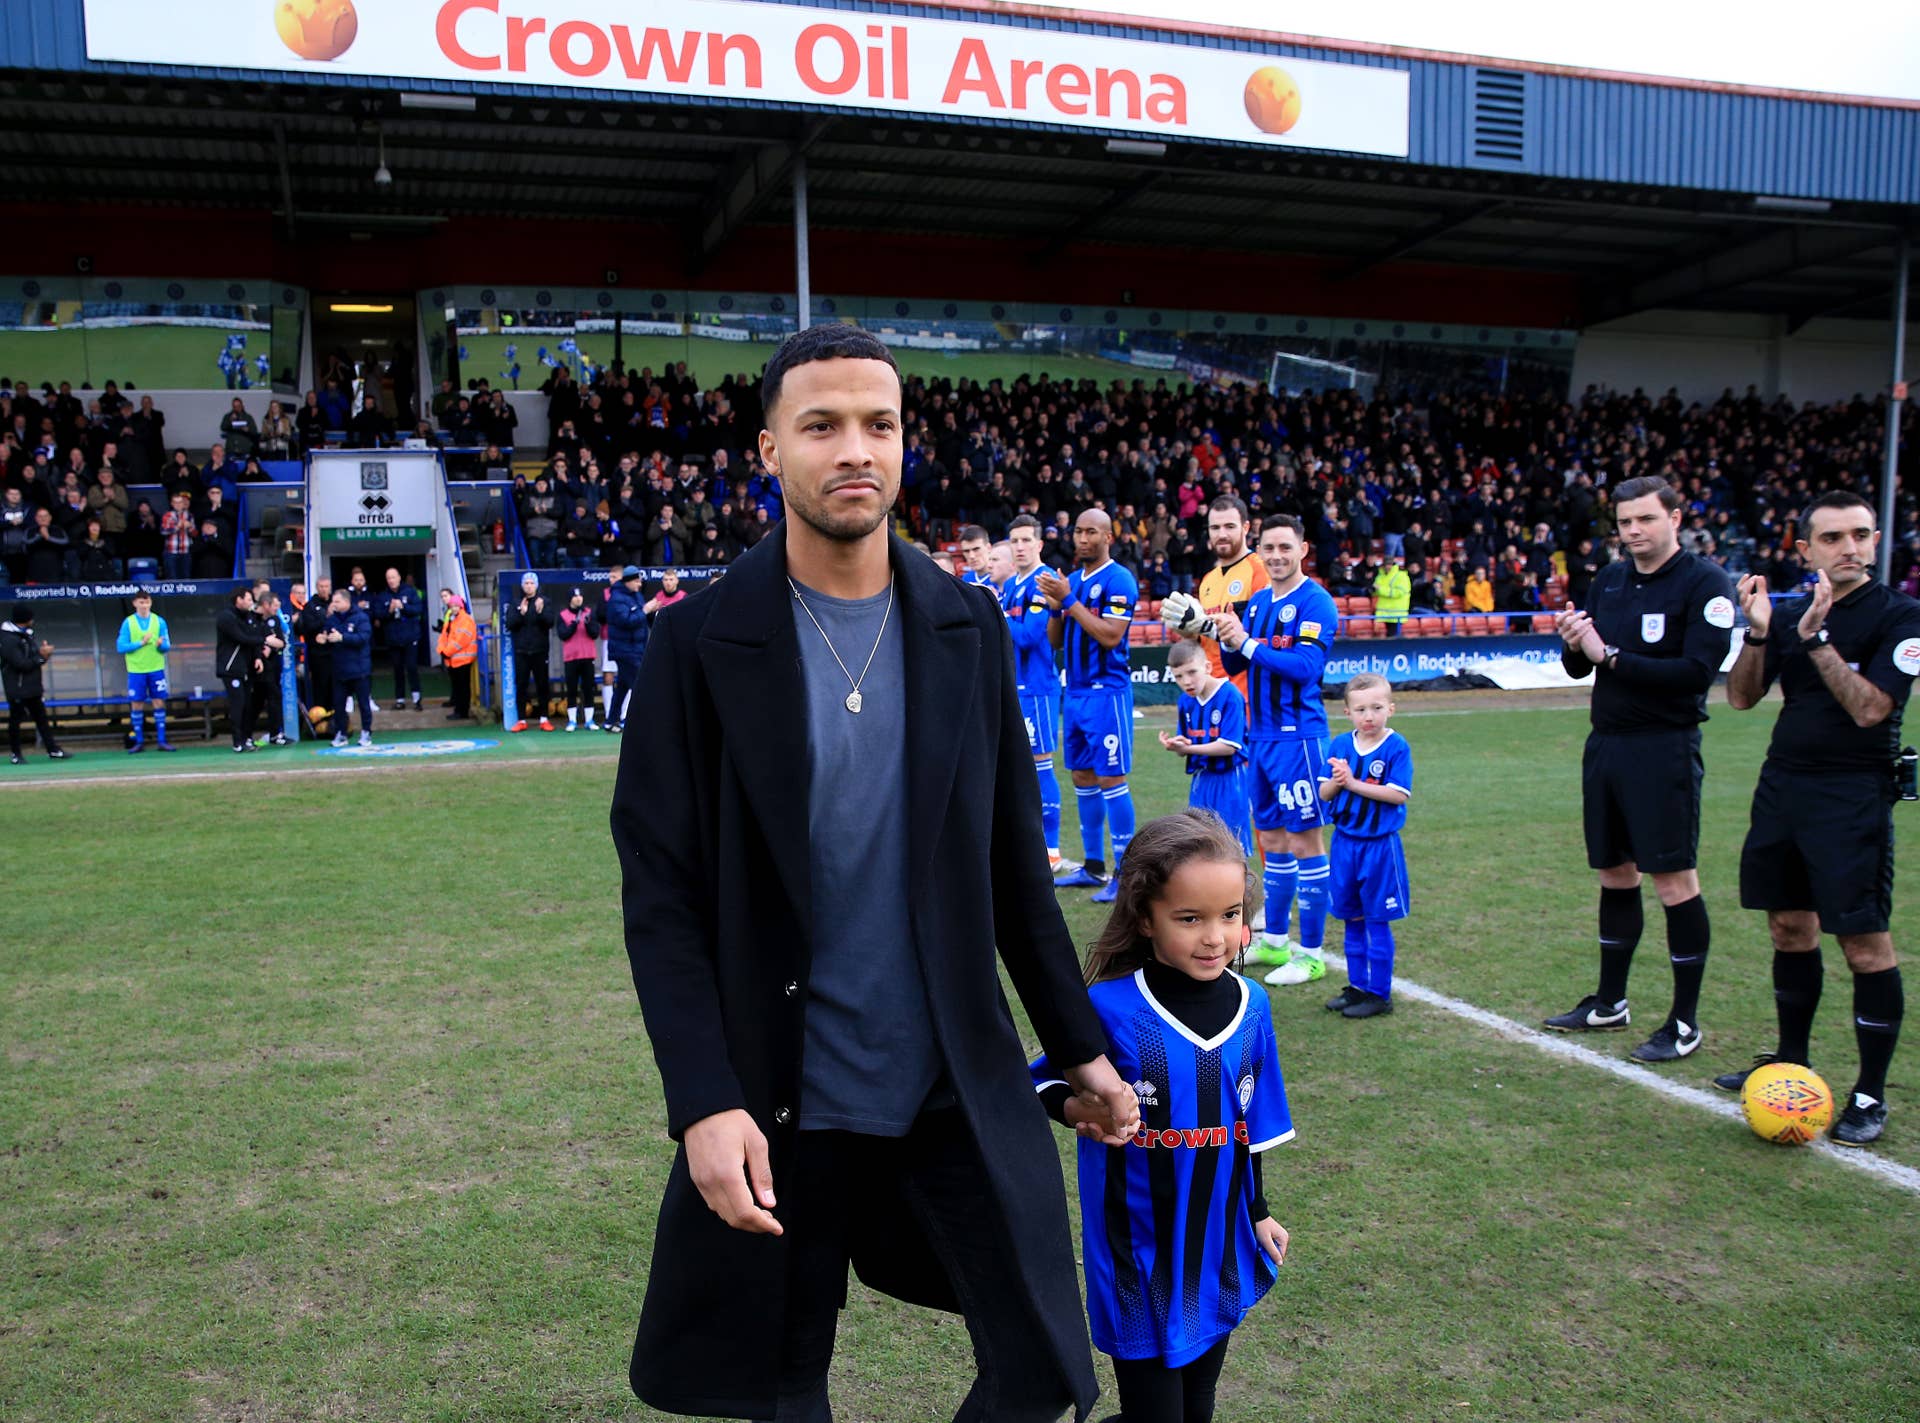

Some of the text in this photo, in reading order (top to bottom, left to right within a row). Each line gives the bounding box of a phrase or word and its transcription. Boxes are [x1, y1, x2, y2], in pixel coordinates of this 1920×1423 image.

[436, 0, 1188, 125] Crown Oil Arena
[77, 257, 89, 272] C
[346, 529, 372, 538] EXIT
[375, 528, 406, 537] GATE
[15, 586, 65, 599] Supported
[66, 586, 78, 598] by
[95, 584, 139, 595] Rochdale
[176, 584, 197, 595] shop
[1325, 655, 1368, 675] orted
[1372, 655, 1391, 677] by
[1103, 734, 1119, 756] 9
[1279, 780, 1314, 811] 40
